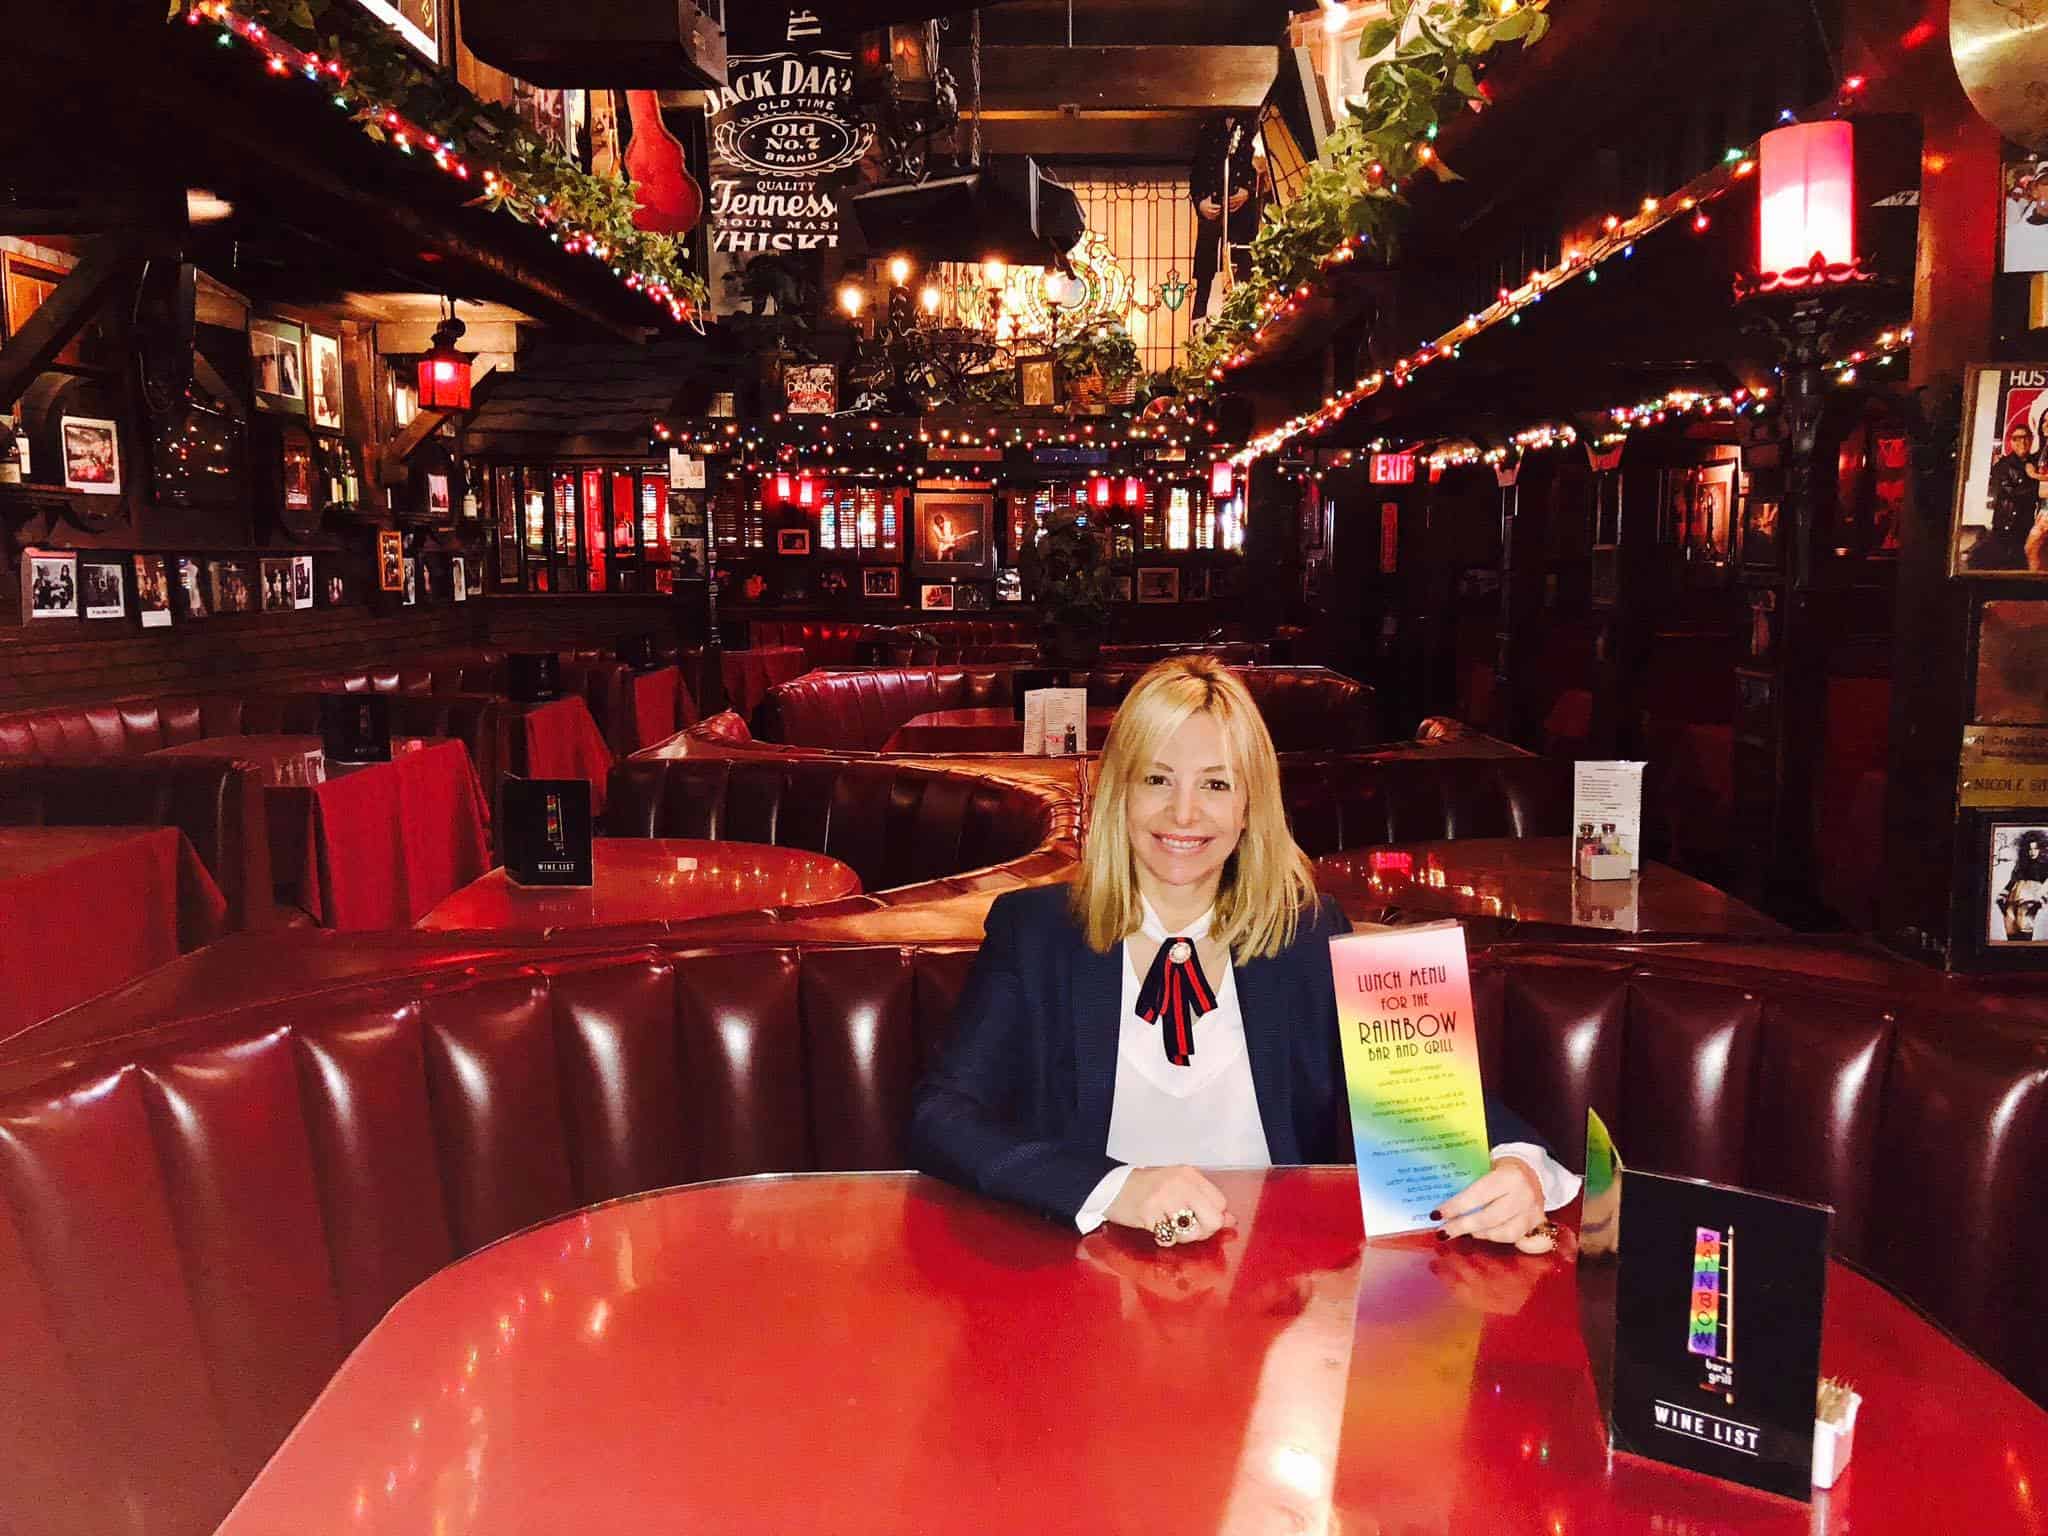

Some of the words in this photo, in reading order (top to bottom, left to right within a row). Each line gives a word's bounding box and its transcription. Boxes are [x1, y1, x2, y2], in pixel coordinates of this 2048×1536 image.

[704, 69, 776, 118] JACK
[757, 99, 790, 112] OLD
[797, 98, 836, 111] TIME
[771, 123, 815, 136] Old
[765, 152, 817, 163] BRAND
[756, 180, 816, 193] QUALITY
[710, 179, 838, 218] Tenness
[719, 218, 773, 229] SOUR
[2009, 370, 2048, 387] HUS
[1376, 456, 1409, 481] EXIT
[538, 863, 556, 871] WINE
[559, 863, 574, 871] LIST
[1357, 971, 1401, 993] LUNCH
[1409, 965, 1447, 987] MENU
[1381, 996, 1408, 1011] FOR
[1412, 993, 1429, 1007] THE
[1358, 1010, 1457, 1044] RAINBOW
[1368, 1046, 1391, 1061] BAR
[1396, 1043, 1418, 1058] AND
[1424, 1038, 1453, 1054] GRILL
[1695, 1232, 1715, 1347] RAINBOW
[1705, 1358, 1724, 1373] bar
[1707, 1371, 1733, 1386] grill
[1654, 1405, 1705, 1434] WINE
[1714, 1423, 1759, 1450] LIST
